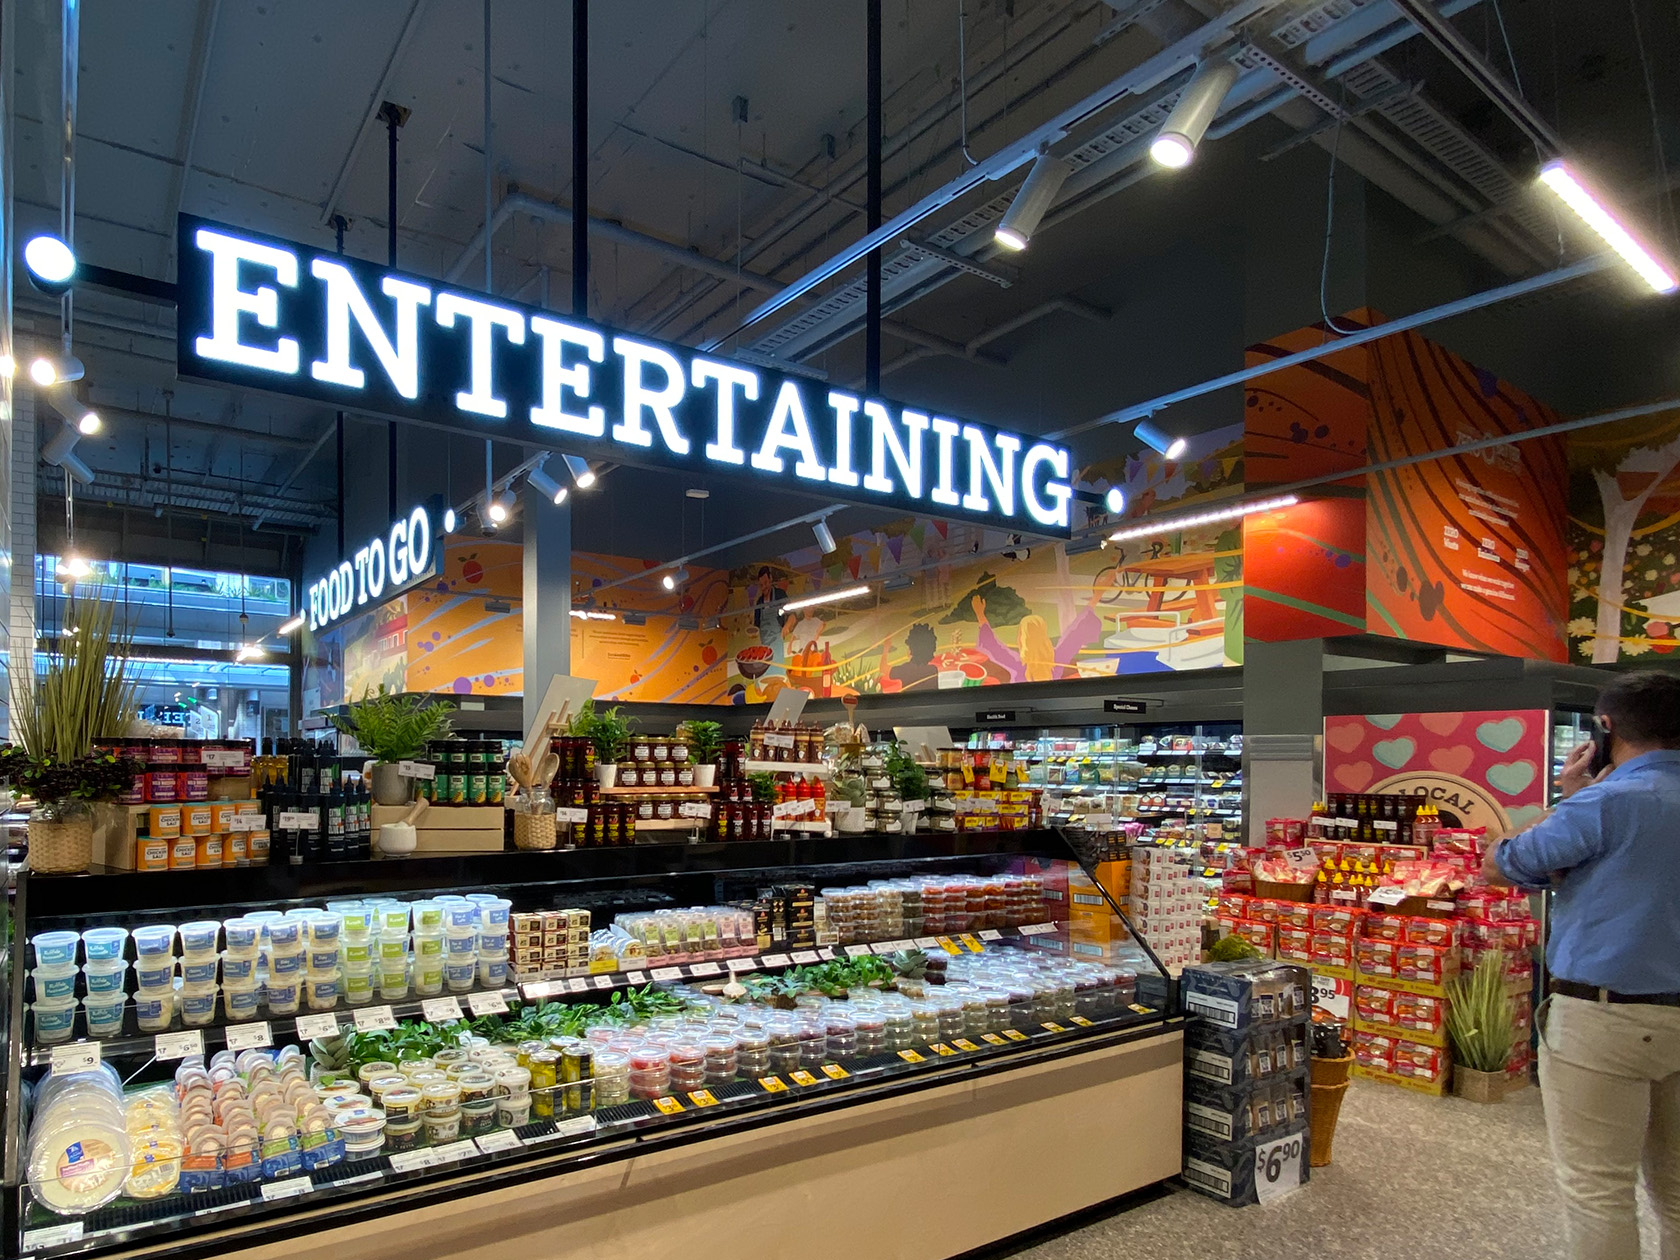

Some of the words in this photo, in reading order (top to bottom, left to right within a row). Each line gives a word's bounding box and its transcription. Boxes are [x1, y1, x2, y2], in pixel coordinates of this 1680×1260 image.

[195, 228, 1072, 527] ENTERTAINING
[309, 561, 354, 631] FOOD
[355, 538, 385, 605] TO
[389, 506, 430, 585] GO
[82, 1057, 94, 1065] $9
[1257, 1140, 1300, 1183] $690
